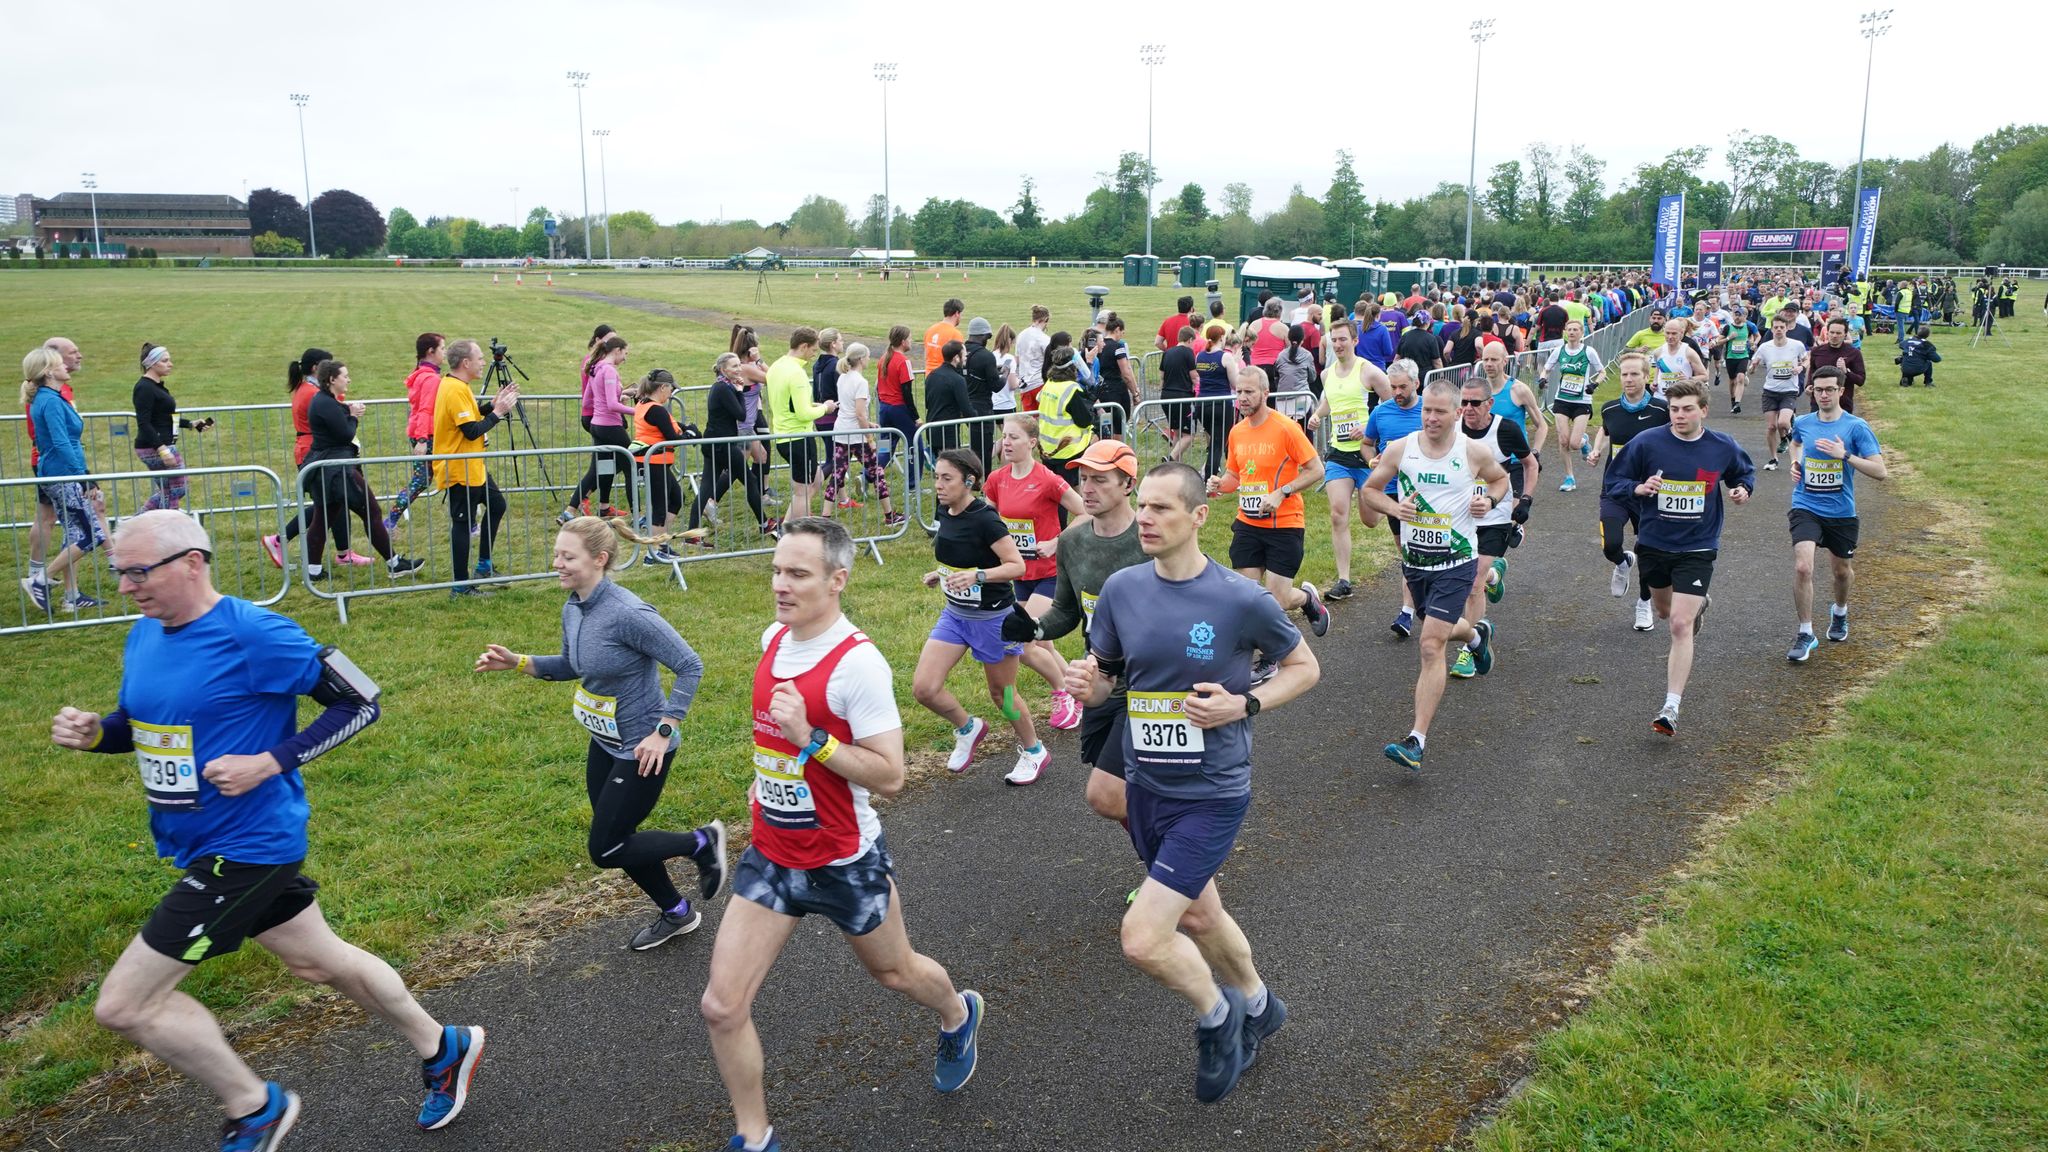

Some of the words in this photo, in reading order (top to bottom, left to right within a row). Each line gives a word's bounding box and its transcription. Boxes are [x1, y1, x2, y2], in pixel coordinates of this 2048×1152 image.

[1752, 234, 1794, 243] REUNION
[1417, 472, 1450, 485] NEIL
[1809, 472, 1835, 484] 2129
[1660, 482, 1703, 493] REUNION
[1241, 496, 1262, 509] 2172
[1665, 496, 1694, 510] 2101
[1412, 528, 1443, 545] 2986
[1186, 646, 1214, 656] FINISHER
[1129, 697, 1185, 714] REUNIO
[580, 710, 609, 734] 2131
[1142, 723, 1188, 747] 3376
